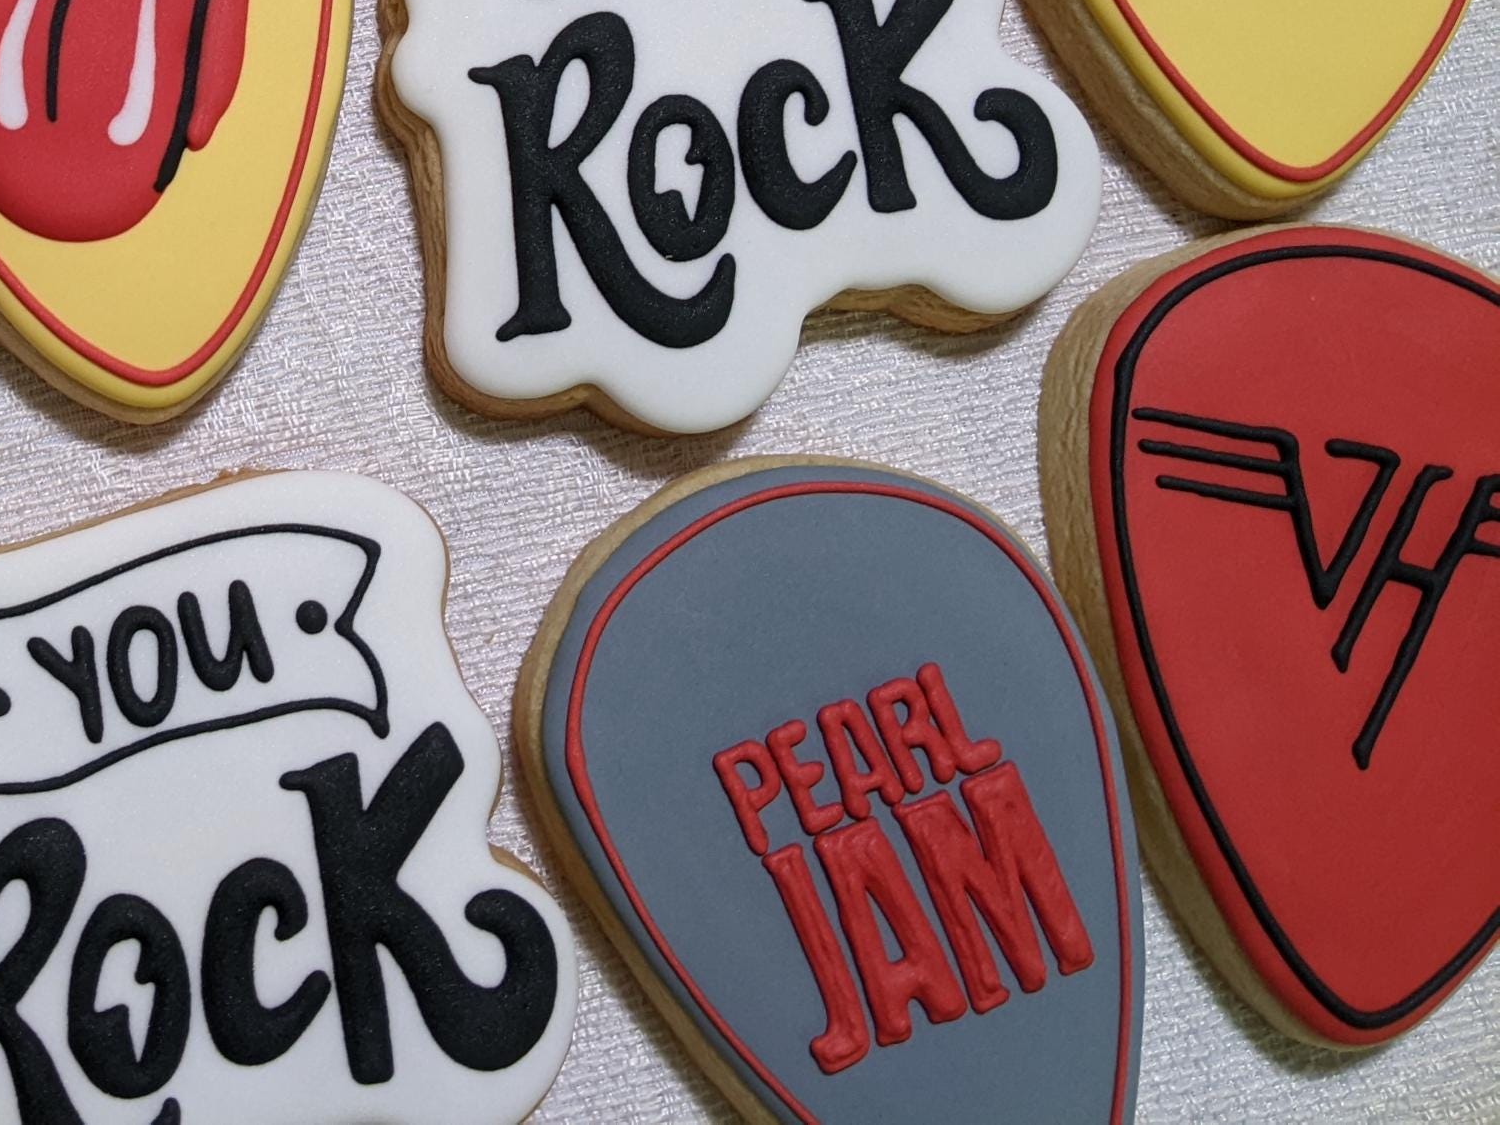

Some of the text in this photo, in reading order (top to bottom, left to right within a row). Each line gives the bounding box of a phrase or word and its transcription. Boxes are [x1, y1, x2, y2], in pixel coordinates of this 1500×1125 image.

[27, 579, 274, 744] YOU
[713, 661, 1002, 856] PEARL
[762, 760, 1094, 1075] JAM
